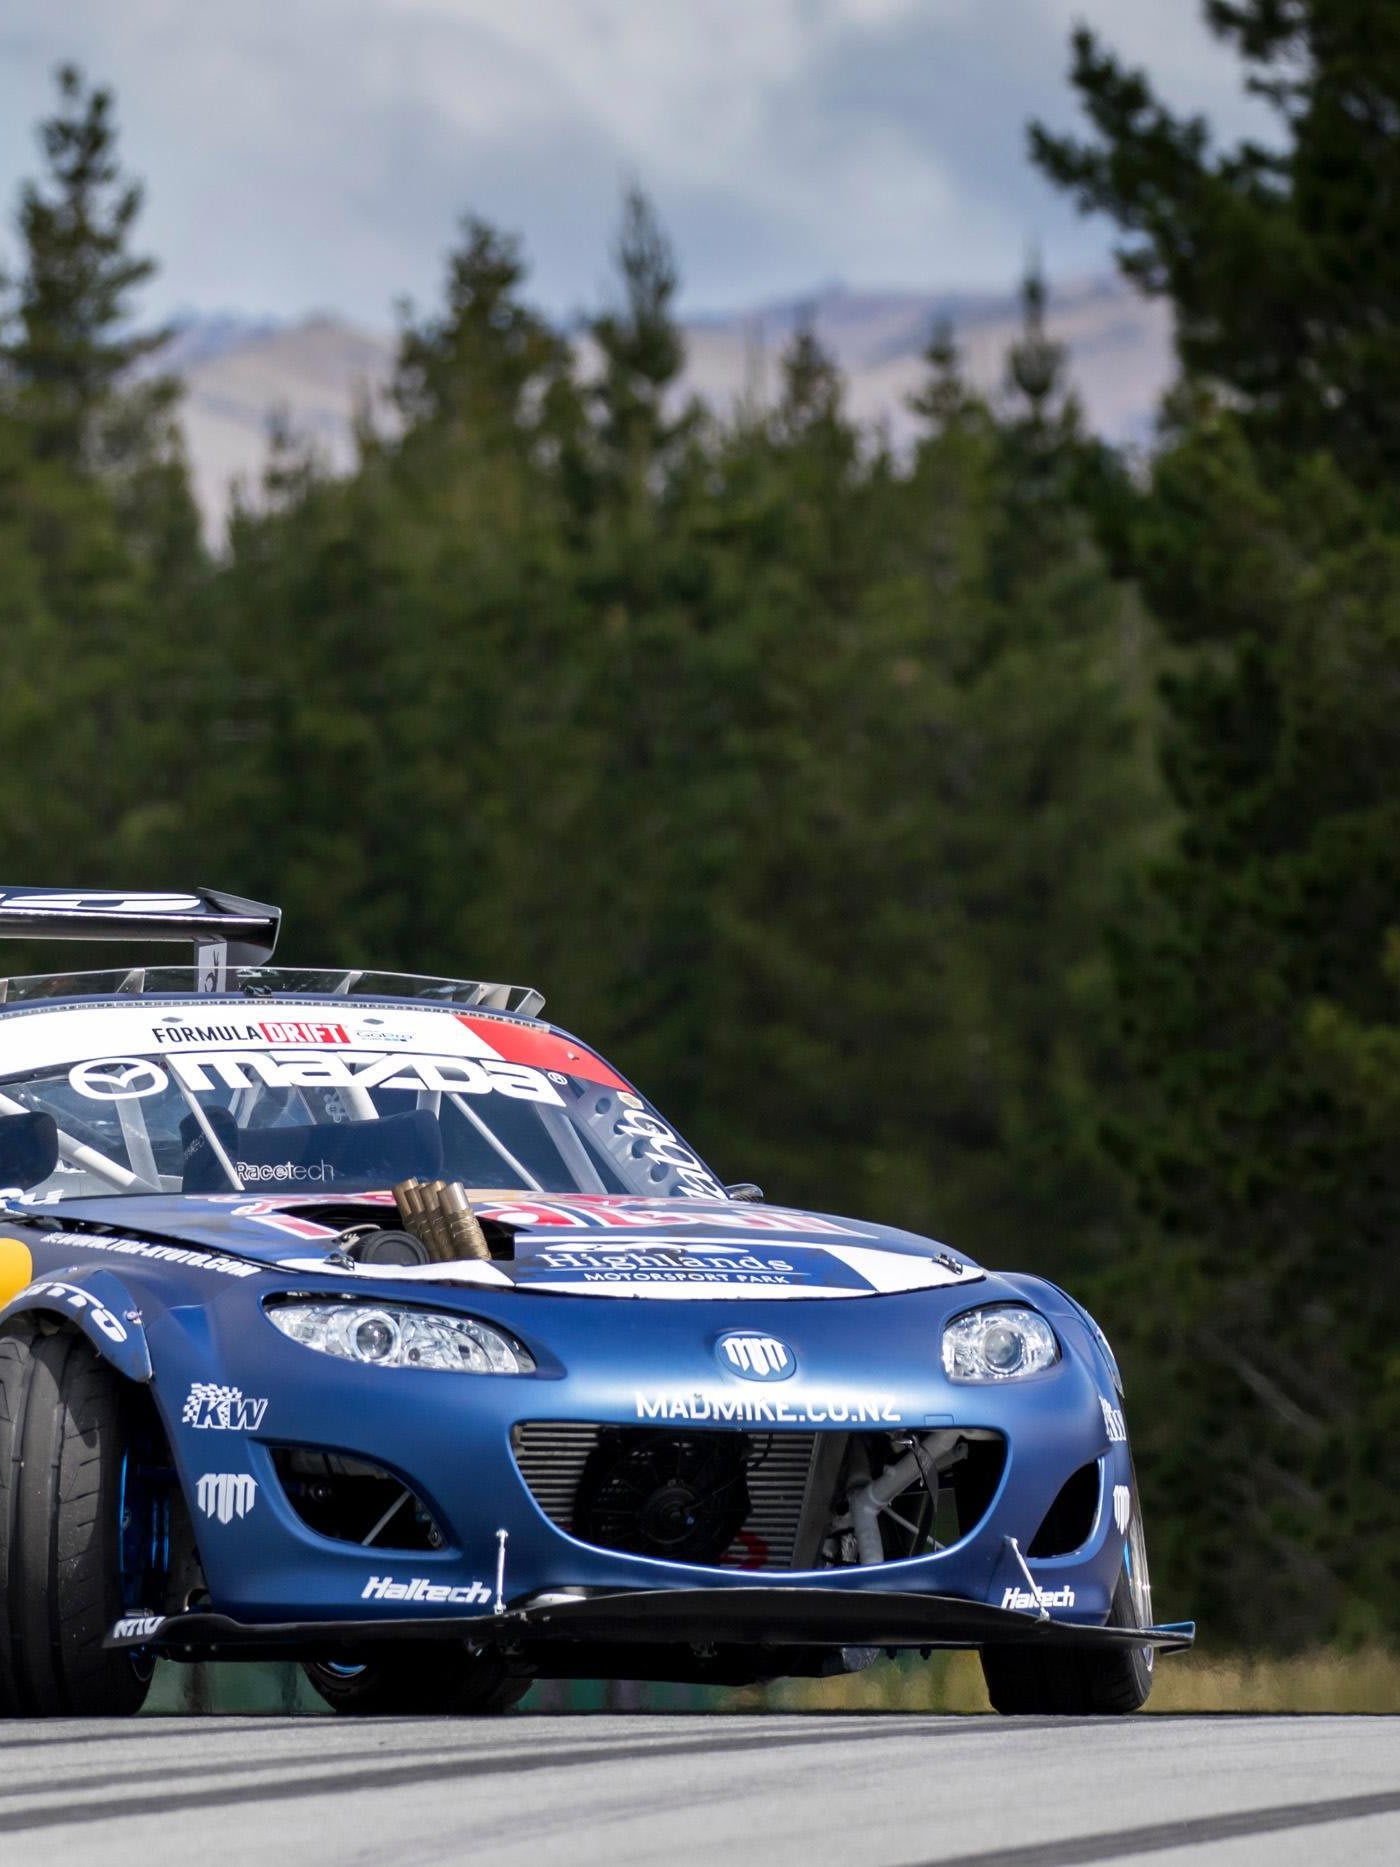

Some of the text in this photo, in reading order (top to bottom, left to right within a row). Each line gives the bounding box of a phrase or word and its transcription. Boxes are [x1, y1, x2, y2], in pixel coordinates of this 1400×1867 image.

[152, 1023, 343, 1044] FORMULA DRIFT
[236, 1159, 335, 1183] Racetech
[536, 1252, 794, 1272] Highlands
[584, 1273, 790, 1284] MOTORSPORT PARK
[193, 1399, 268, 1431] KW
[634, 1392, 901, 1423] MADMIKE.CO.NZ
[361, 1577, 491, 1604] Haltech
